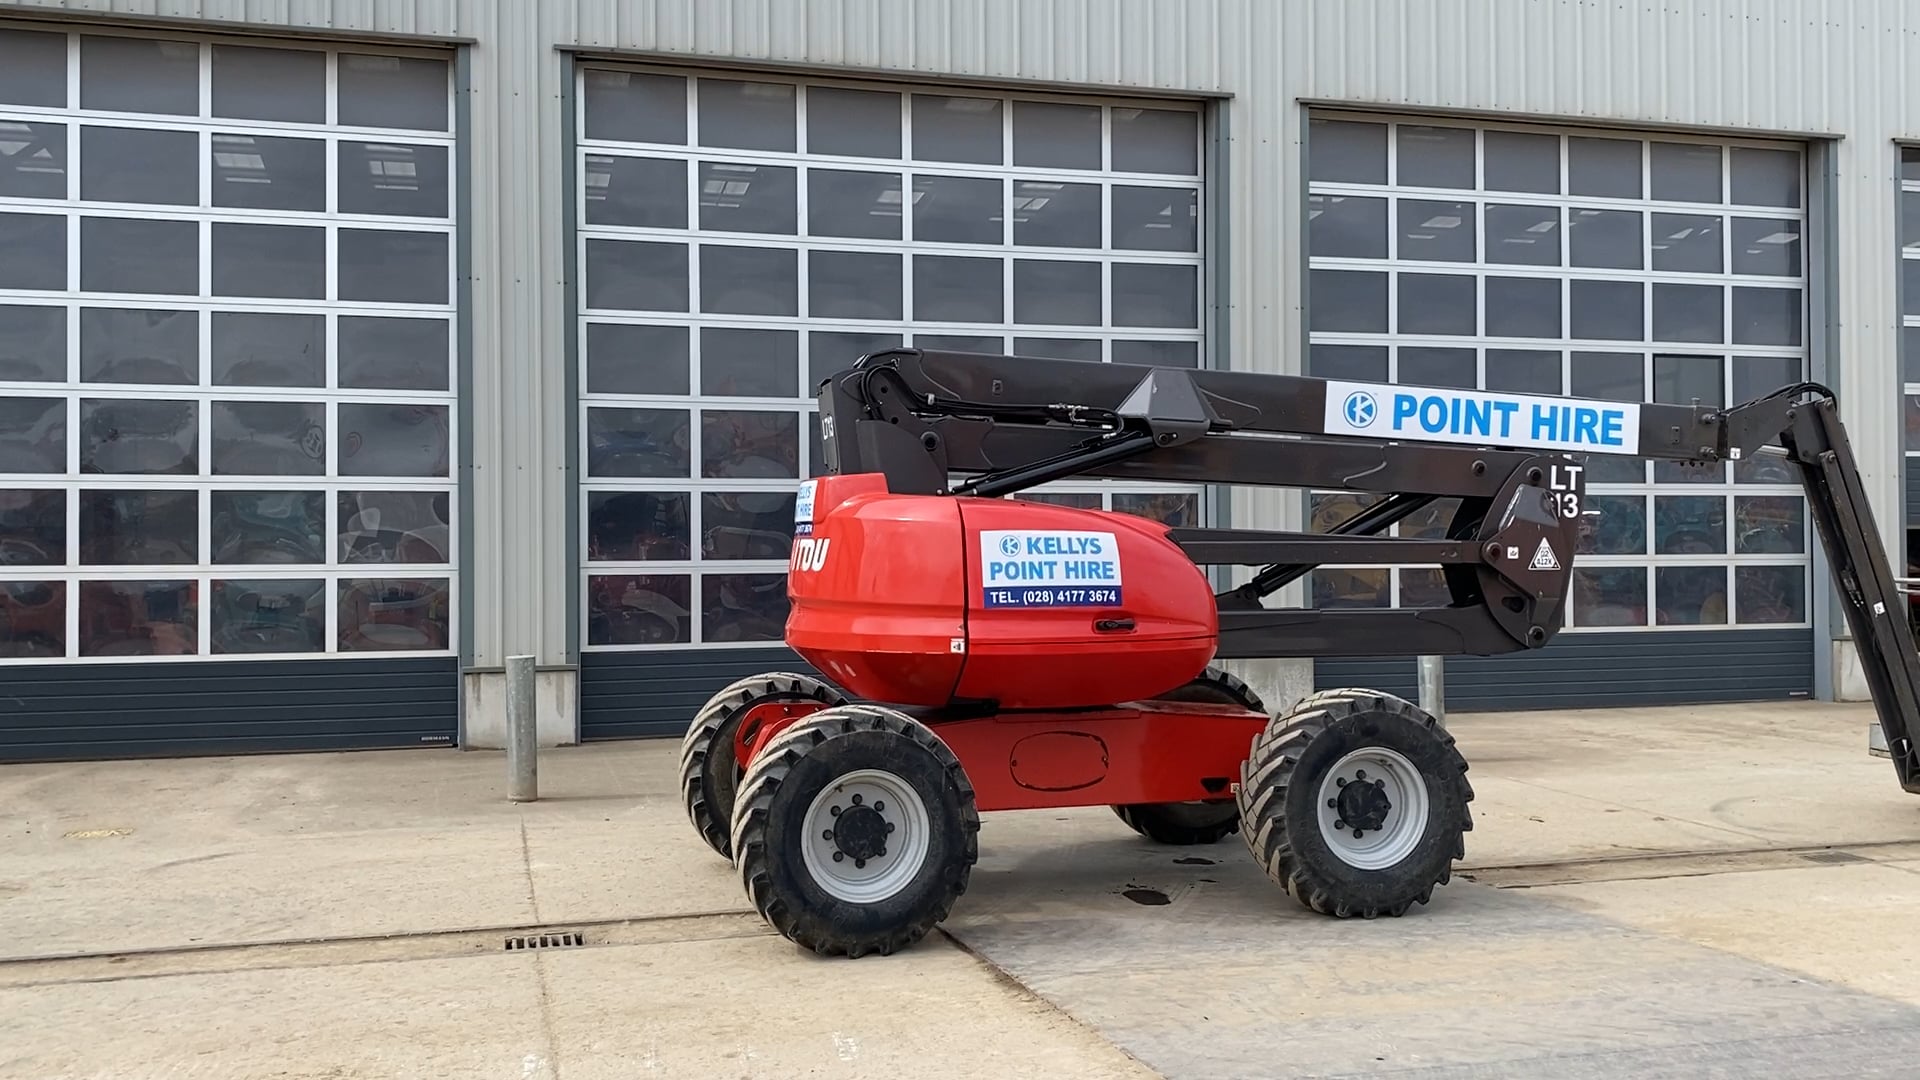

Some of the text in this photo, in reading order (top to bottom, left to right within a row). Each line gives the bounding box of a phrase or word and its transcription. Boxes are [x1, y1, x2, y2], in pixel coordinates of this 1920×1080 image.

[1393, 393, 1519, 438] POINT
[1530, 404, 1624, 446] HIRE
[1550, 465, 1583, 491] LT
[1026, 537, 1102, 555] KELLYS
[990, 561, 1115, 581] POINT HIRE
[990, 590, 1116, 605] TEL. (028) 4177 3674
